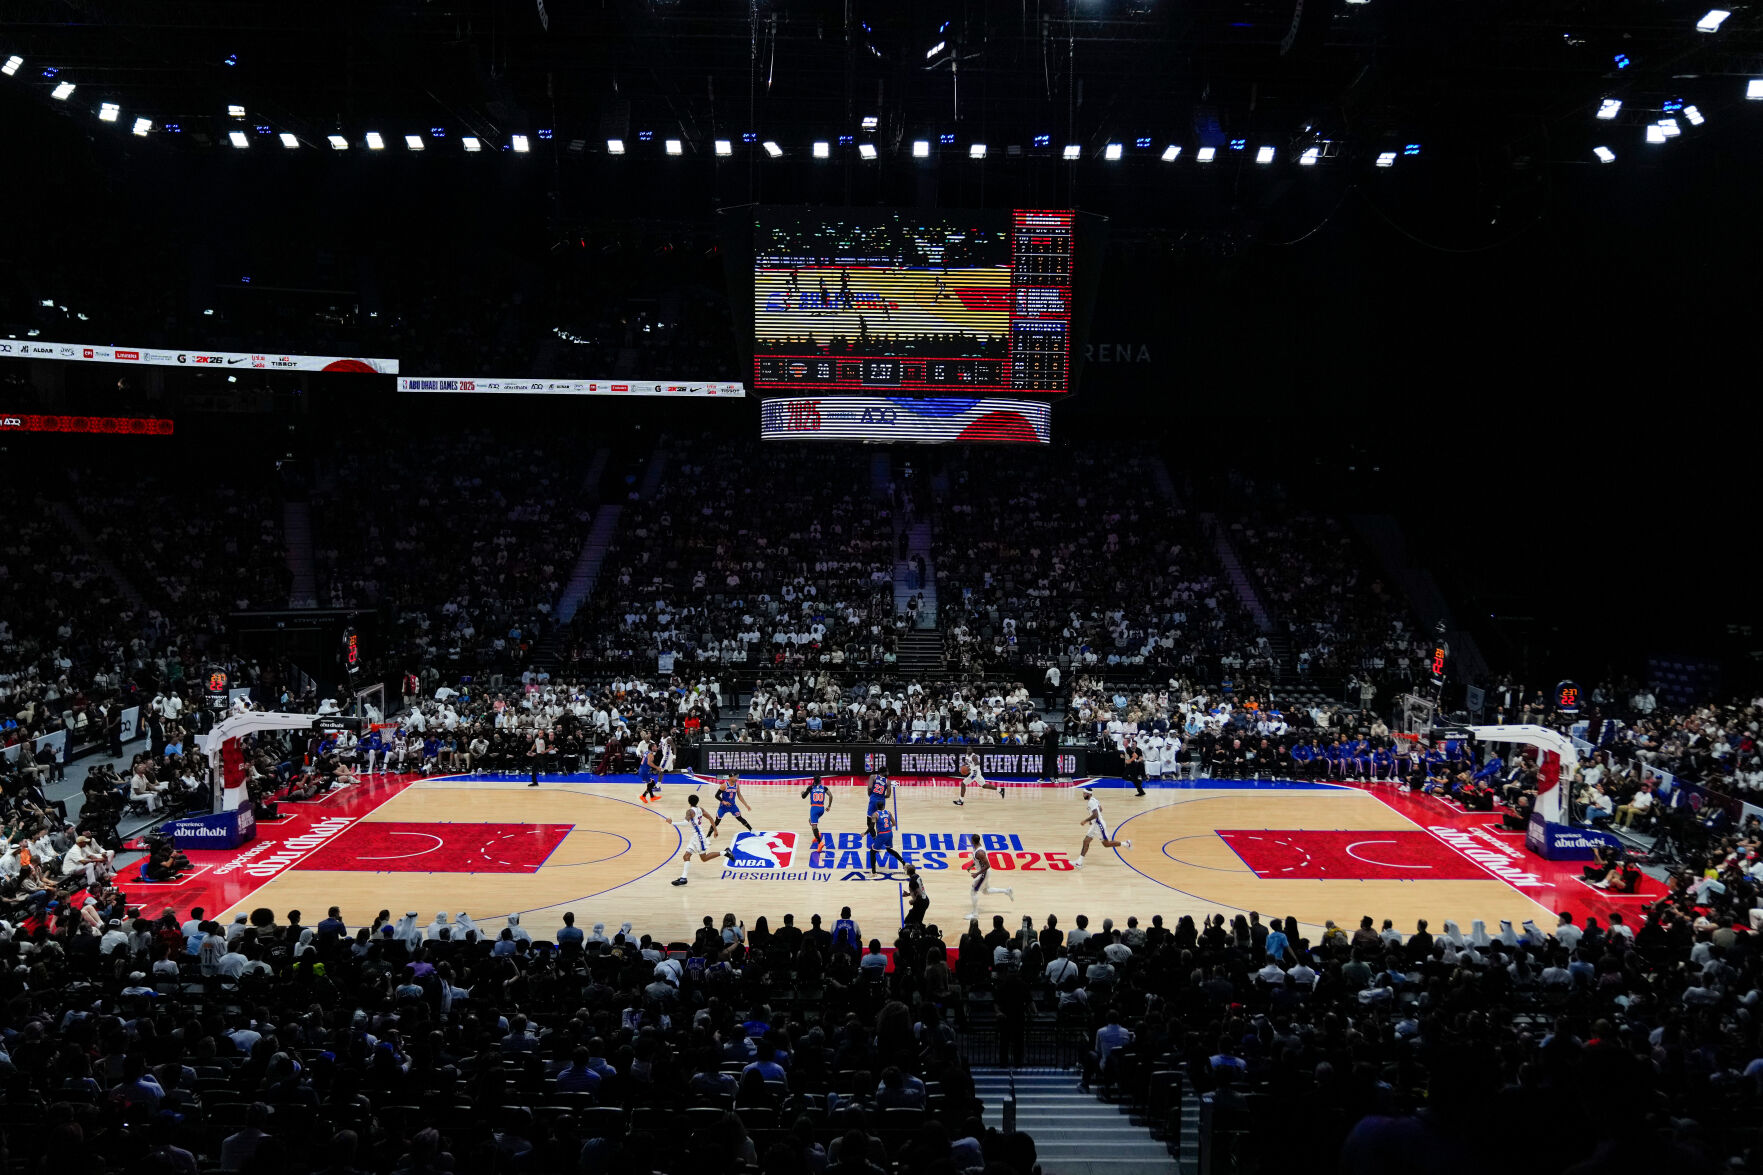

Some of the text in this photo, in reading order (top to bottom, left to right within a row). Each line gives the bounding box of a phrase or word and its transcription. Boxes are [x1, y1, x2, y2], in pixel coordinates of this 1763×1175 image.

[1085, 343, 1152, 362] RENA
[409, 380, 420, 390] ABU
[421, 380, 438, 390] DHABI
[440, 380, 458, 391] GAMES
[460, 380, 475, 391] 2025
[4, 417, 21, 426] ADQ
[209, 680, 223, 691] 22
[1560, 695, 1575, 705] 22
[708, 751, 851, 772] REWARDS FOR EVERY FAN
[901, 753, 956, 773] REWARDS
[983, 753, 1020, 773] EVERY
[1021, 754, 1043, 774] FAN
[873, 783, 885, 795] 23
[812, 792, 824, 802] 00
[884, 817, 890, 828] 2
[174, 826, 228, 837] abu dhabi
[244, 850, 306, 877] abu
[282, 816, 358, 850] dhabi
[901, 832, 1024, 851] DHABI
[1554, 838, 1575, 848] abu
[808, 850, 1075, 871] GAMES 2025
[1427, 825, 1557, 888] abu dhabi
[734, 859, 766, 867] NBA
[720, 870, 832, 883] Presented by
